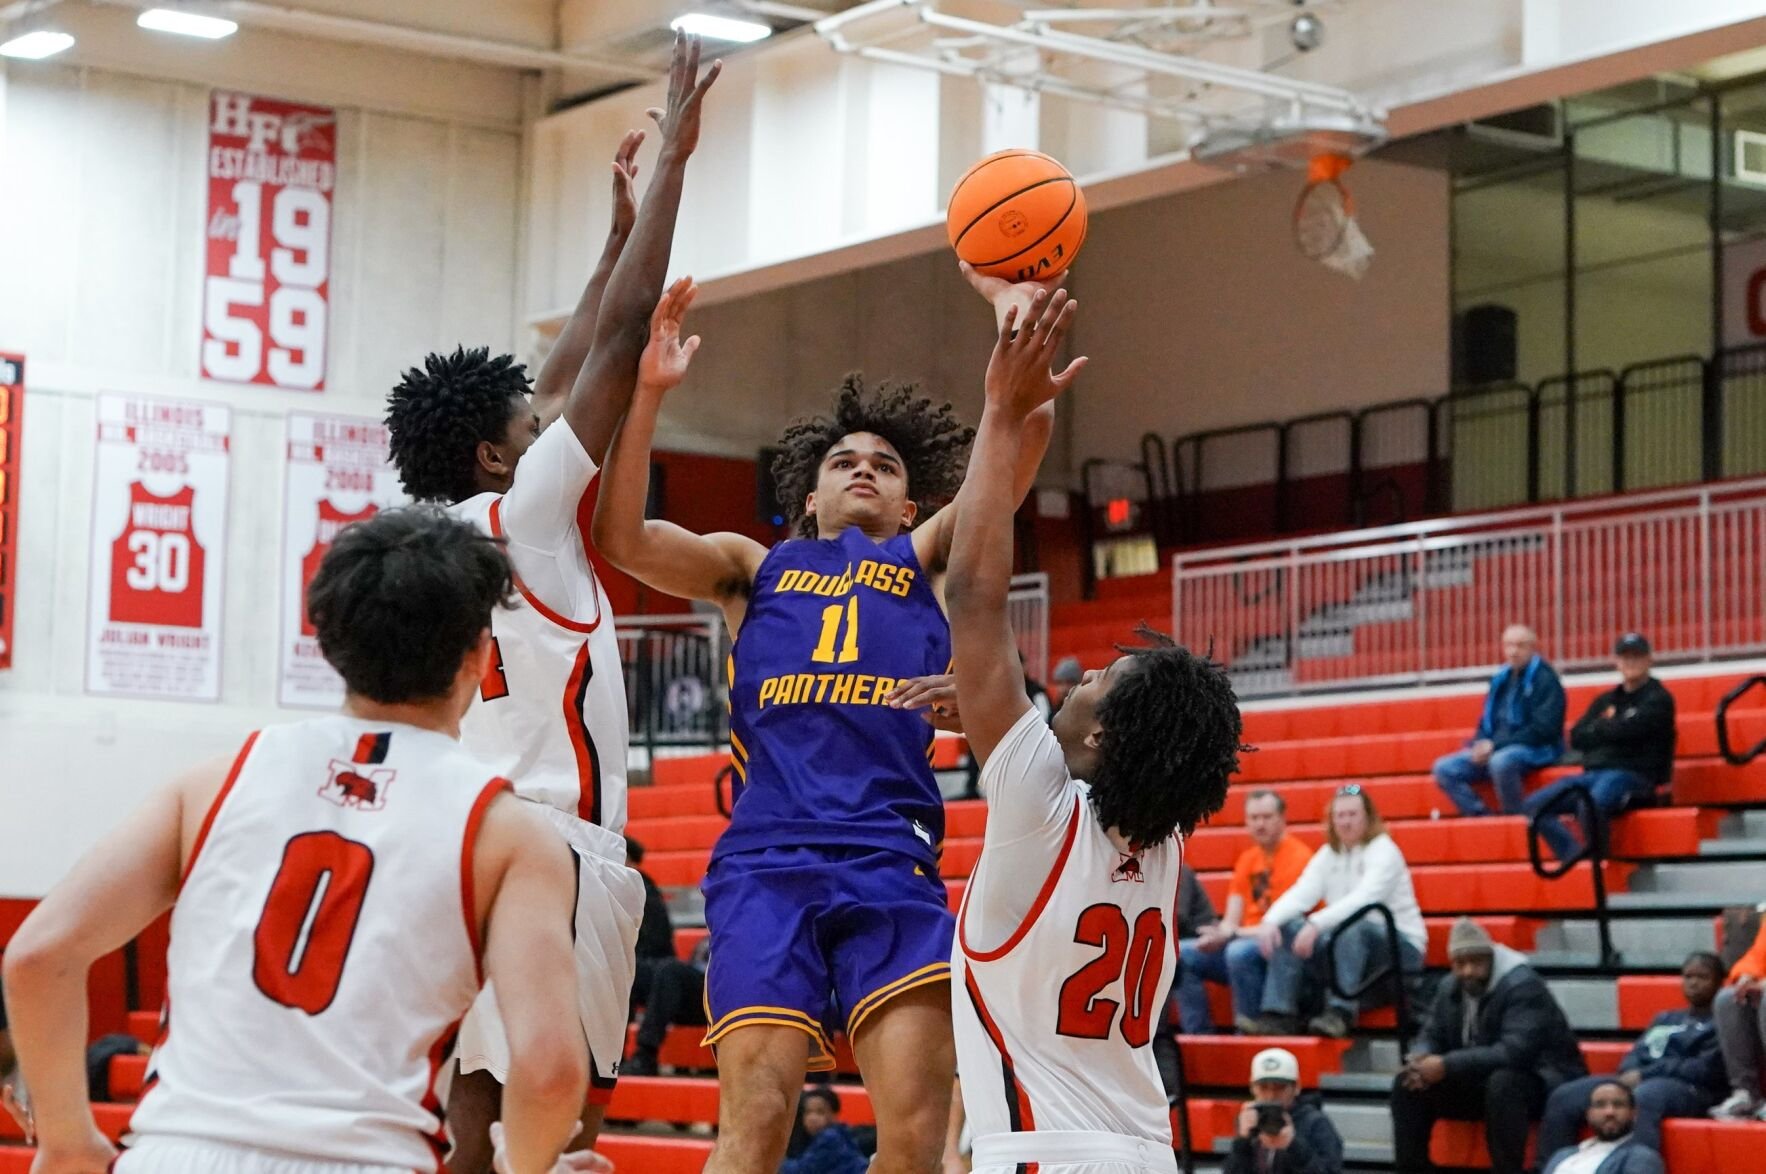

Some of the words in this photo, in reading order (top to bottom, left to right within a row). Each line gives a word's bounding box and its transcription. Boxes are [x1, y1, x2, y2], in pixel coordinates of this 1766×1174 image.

[209, 146, 335, 193] ESTABLISHED
[228, 181, 329, 285] 19
[203, 276, 327, 386] 59
[125, 402, 203, 429] ILLINOIS
[313, 419, 388, 447] ILLINOIS
[132, 501, 189, 531] WRIGHT
[126, 529, 190, 593] 30
[156, 632, 210, 651] WRIGHT
[811, 594, 859, 664] 11
[253, 829, 375, 1017] 0
[1056, 902, 1166, 1049] 20
